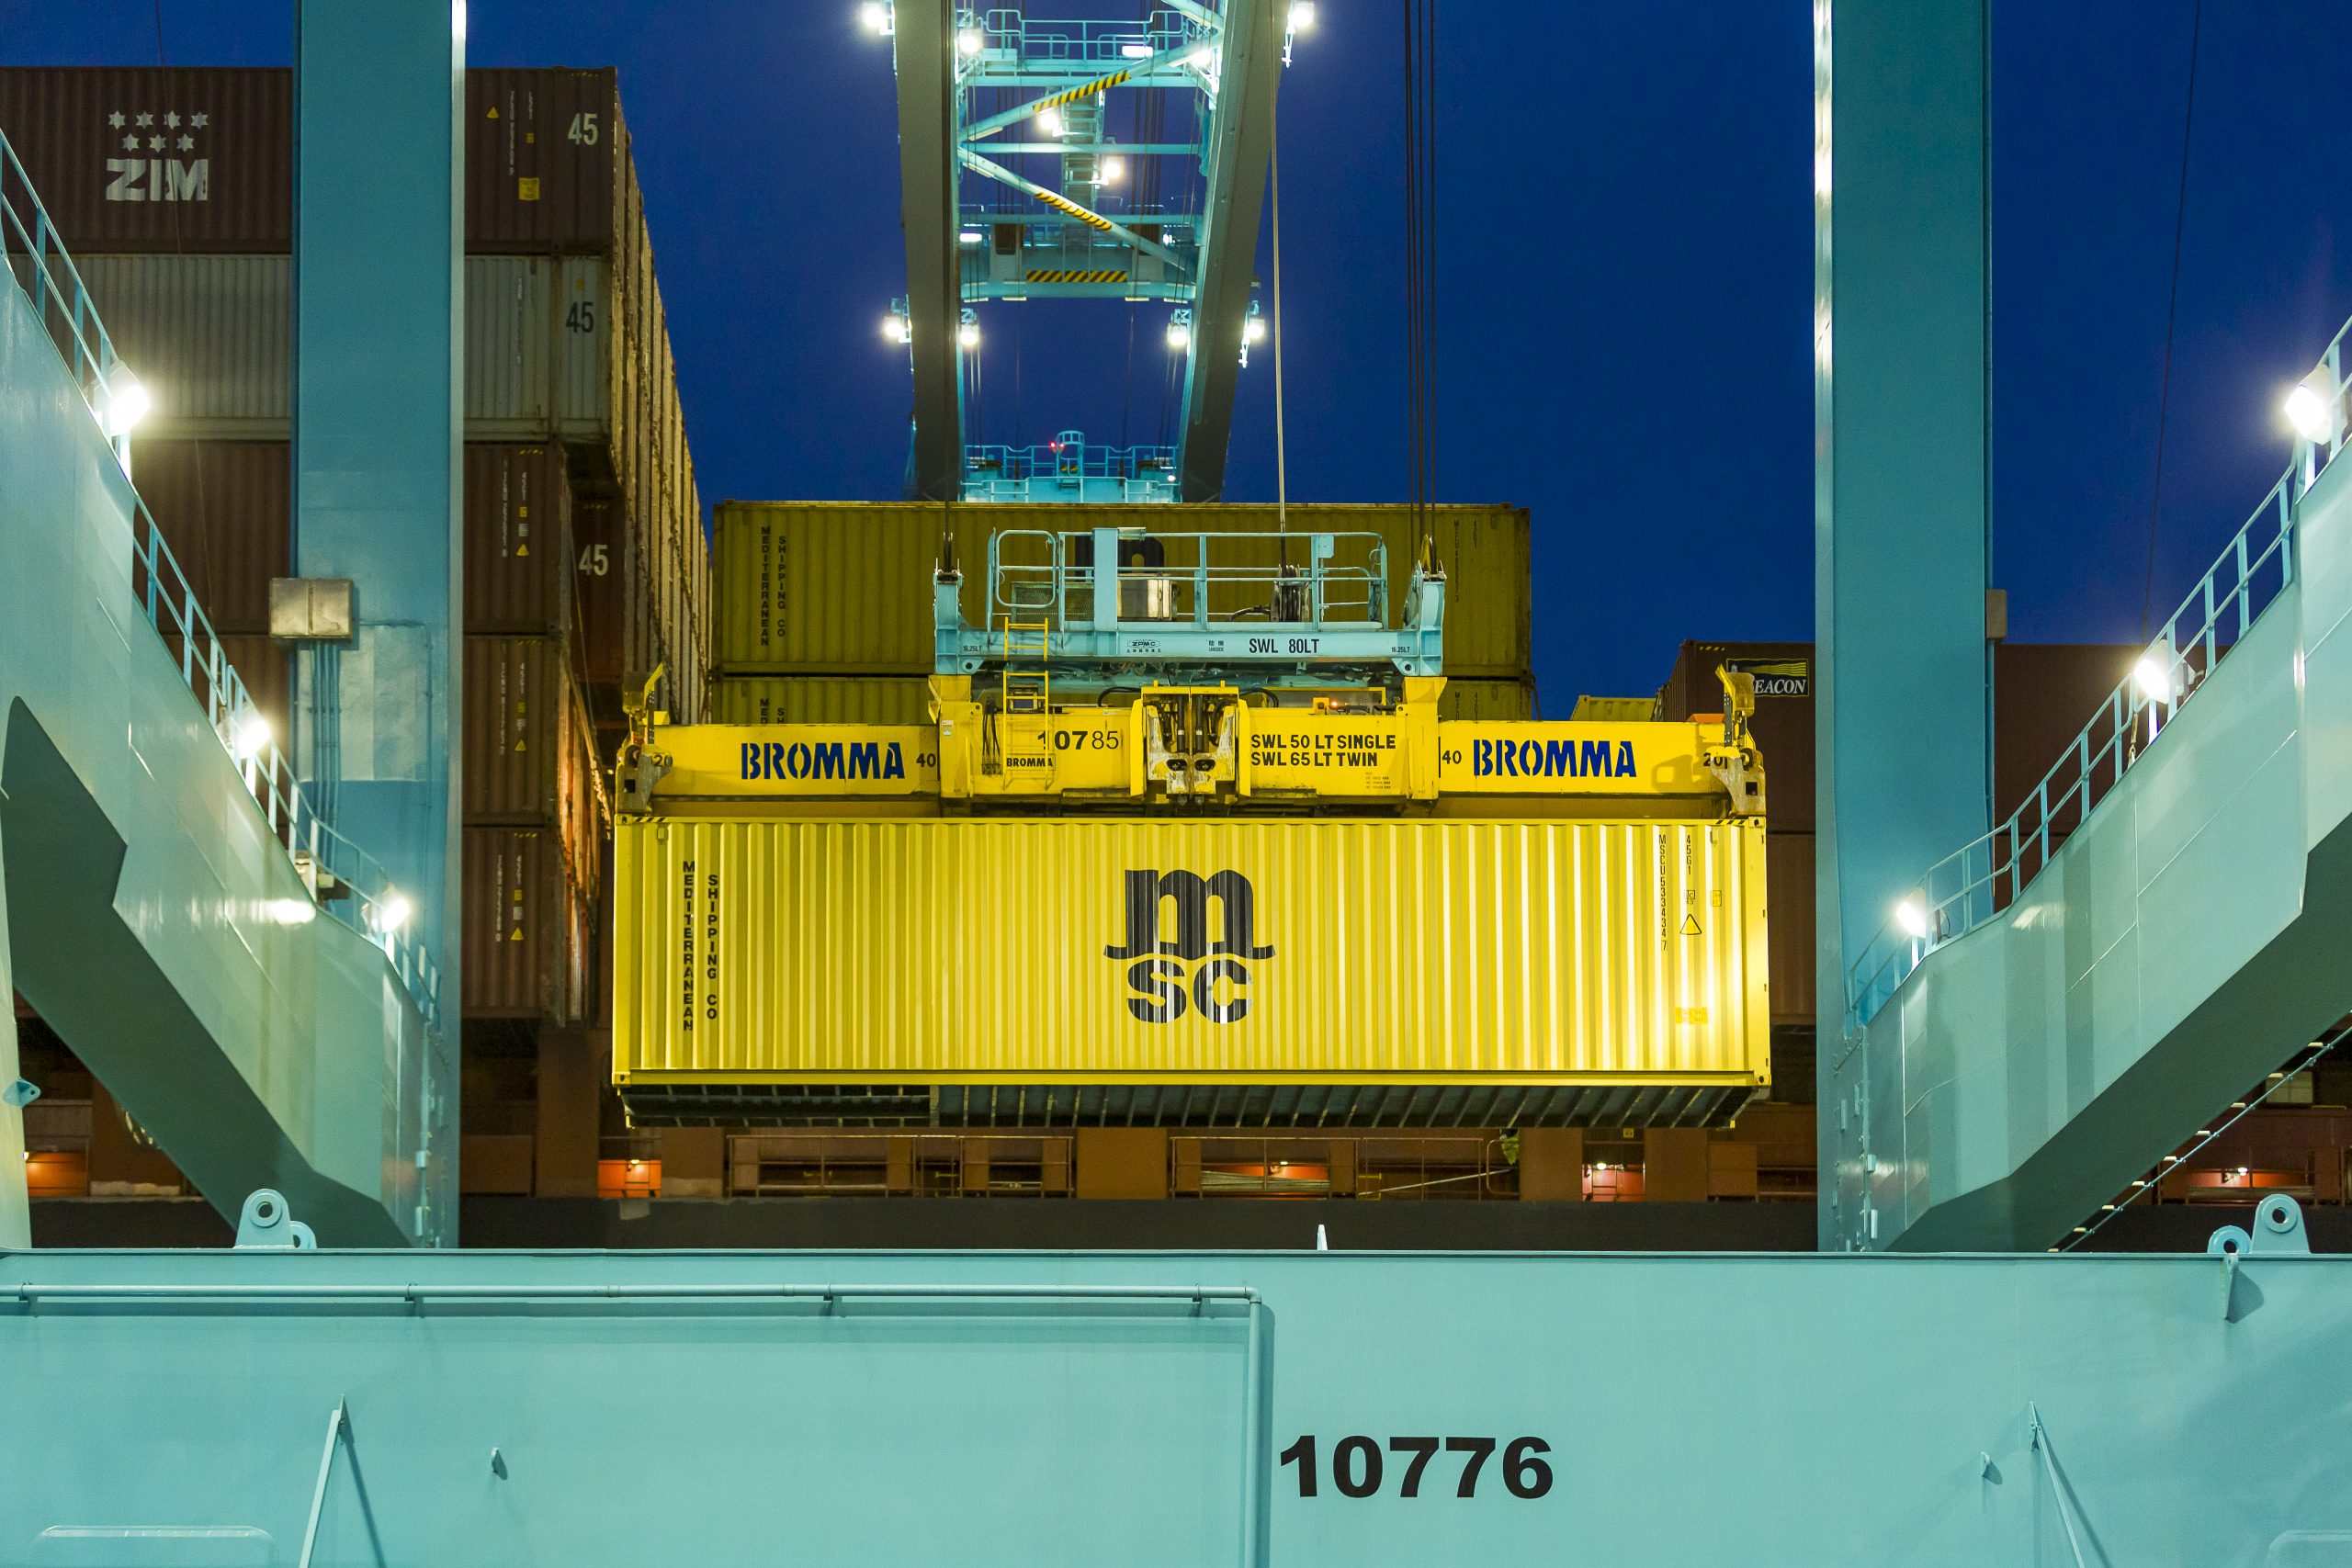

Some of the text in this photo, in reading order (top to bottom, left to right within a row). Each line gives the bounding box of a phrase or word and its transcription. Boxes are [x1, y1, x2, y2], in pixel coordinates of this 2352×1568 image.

[568, 113, 599, 146] 45
[107, 159, 209, 201] ZIM
[566, 301, 594, 333] 45
[579, 544, 608, 576] 45
[761, 526, 770, 646] MEDITERRANEAN
[776, 536, 786, 637] SHIPPING CO
[1249, 638, 1319, 654] SWL 80LT
[1753, 679, 1807, 694] EACON
[1037, 730, 1120, 750] 10785
[1250, 734, 1396, 749] SWL 50 LT SINGLE
[653, 753, 673, 768] 20
[741, 742, 905, 779] BROMMA
[916, 753, 936, 767] 40
[1007, 757, 1054, 768] BROMMA
[1250, 751, 1378, 767] SWL 65 LT TWIN
[1442, 750, 1462, 764] 40
[1474, 739, 1636, 777] BROMMA
[1703, 752, 1724, 767] 20
[1659, 834, 1668, 874] MSCU
[683, 861, 695, 1031] MEDITERRANEAN
[707, 874, 718, 1020] SHIPPING CO
[1281, 1436, 1554, 1500] 10776
